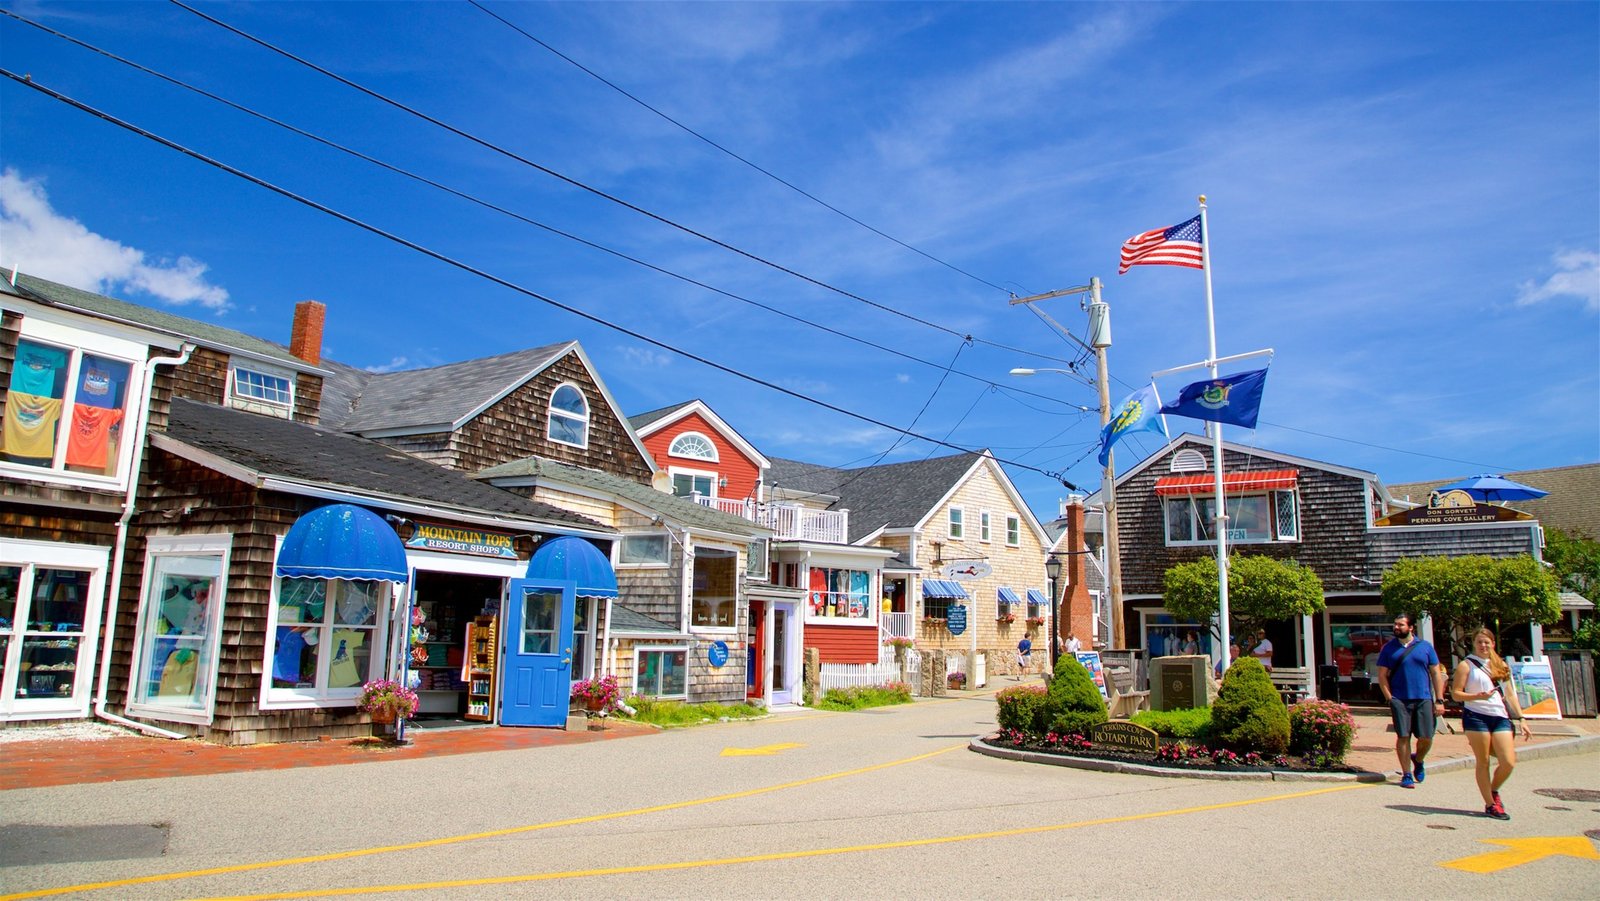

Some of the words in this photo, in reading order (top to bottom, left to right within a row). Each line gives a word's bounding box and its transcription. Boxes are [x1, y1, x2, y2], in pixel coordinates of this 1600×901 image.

[418, 525, 482, 544] MOUNTAIN
[484, 533, 511, 547] TOPS
[1225, 529, 1246, 540] PEN
[428, 539, 468, 550] RESORT
[470, 544, 500, 554] SHOPS
[1102, 722, 1127, 732] PERKINS
[1126, 723, 1146, 736] COVE
[1094, 731, 1129, 743] ROTARY
[1130, 735, 1153, 748] PARK
